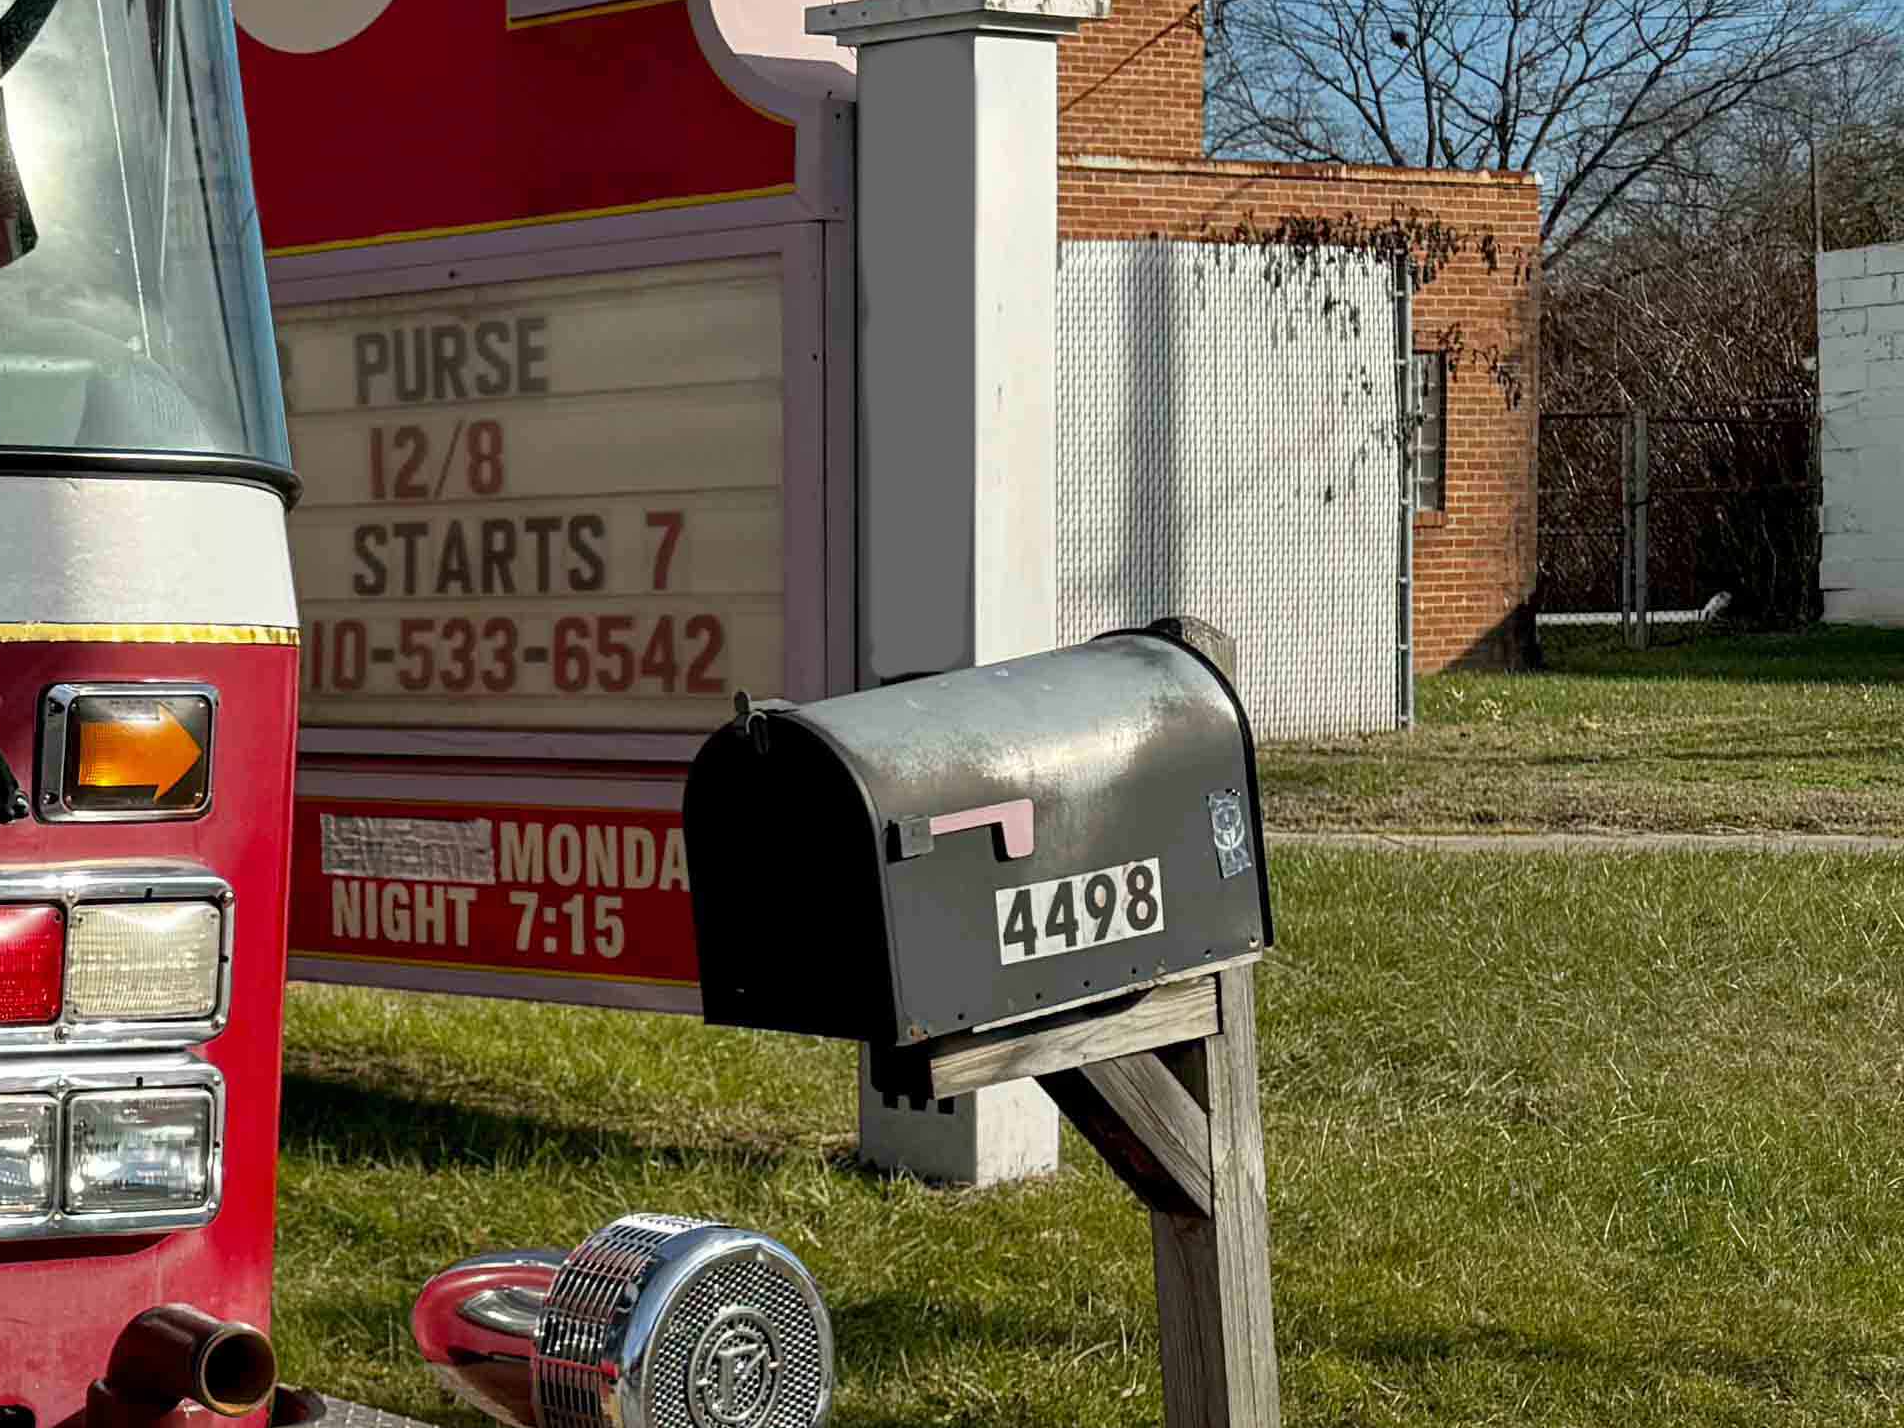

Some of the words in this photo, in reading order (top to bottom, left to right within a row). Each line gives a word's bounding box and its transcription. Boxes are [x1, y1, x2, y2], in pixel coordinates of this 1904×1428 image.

[354, 316, 549, 406] PURSE
[368, 419, 505, 502] 12/8
[352, 514, 607, 598] STARTS
[645, 511, 685, 592] 7
[310, 614, 726, 694] 10-533-6542
[498, 821, 691, 893] MONDA
[331, 879, 478, 948] NIGHT
[509, 890, 626, 959] 7:15
[1002, 864, 1160, 957] 4498
